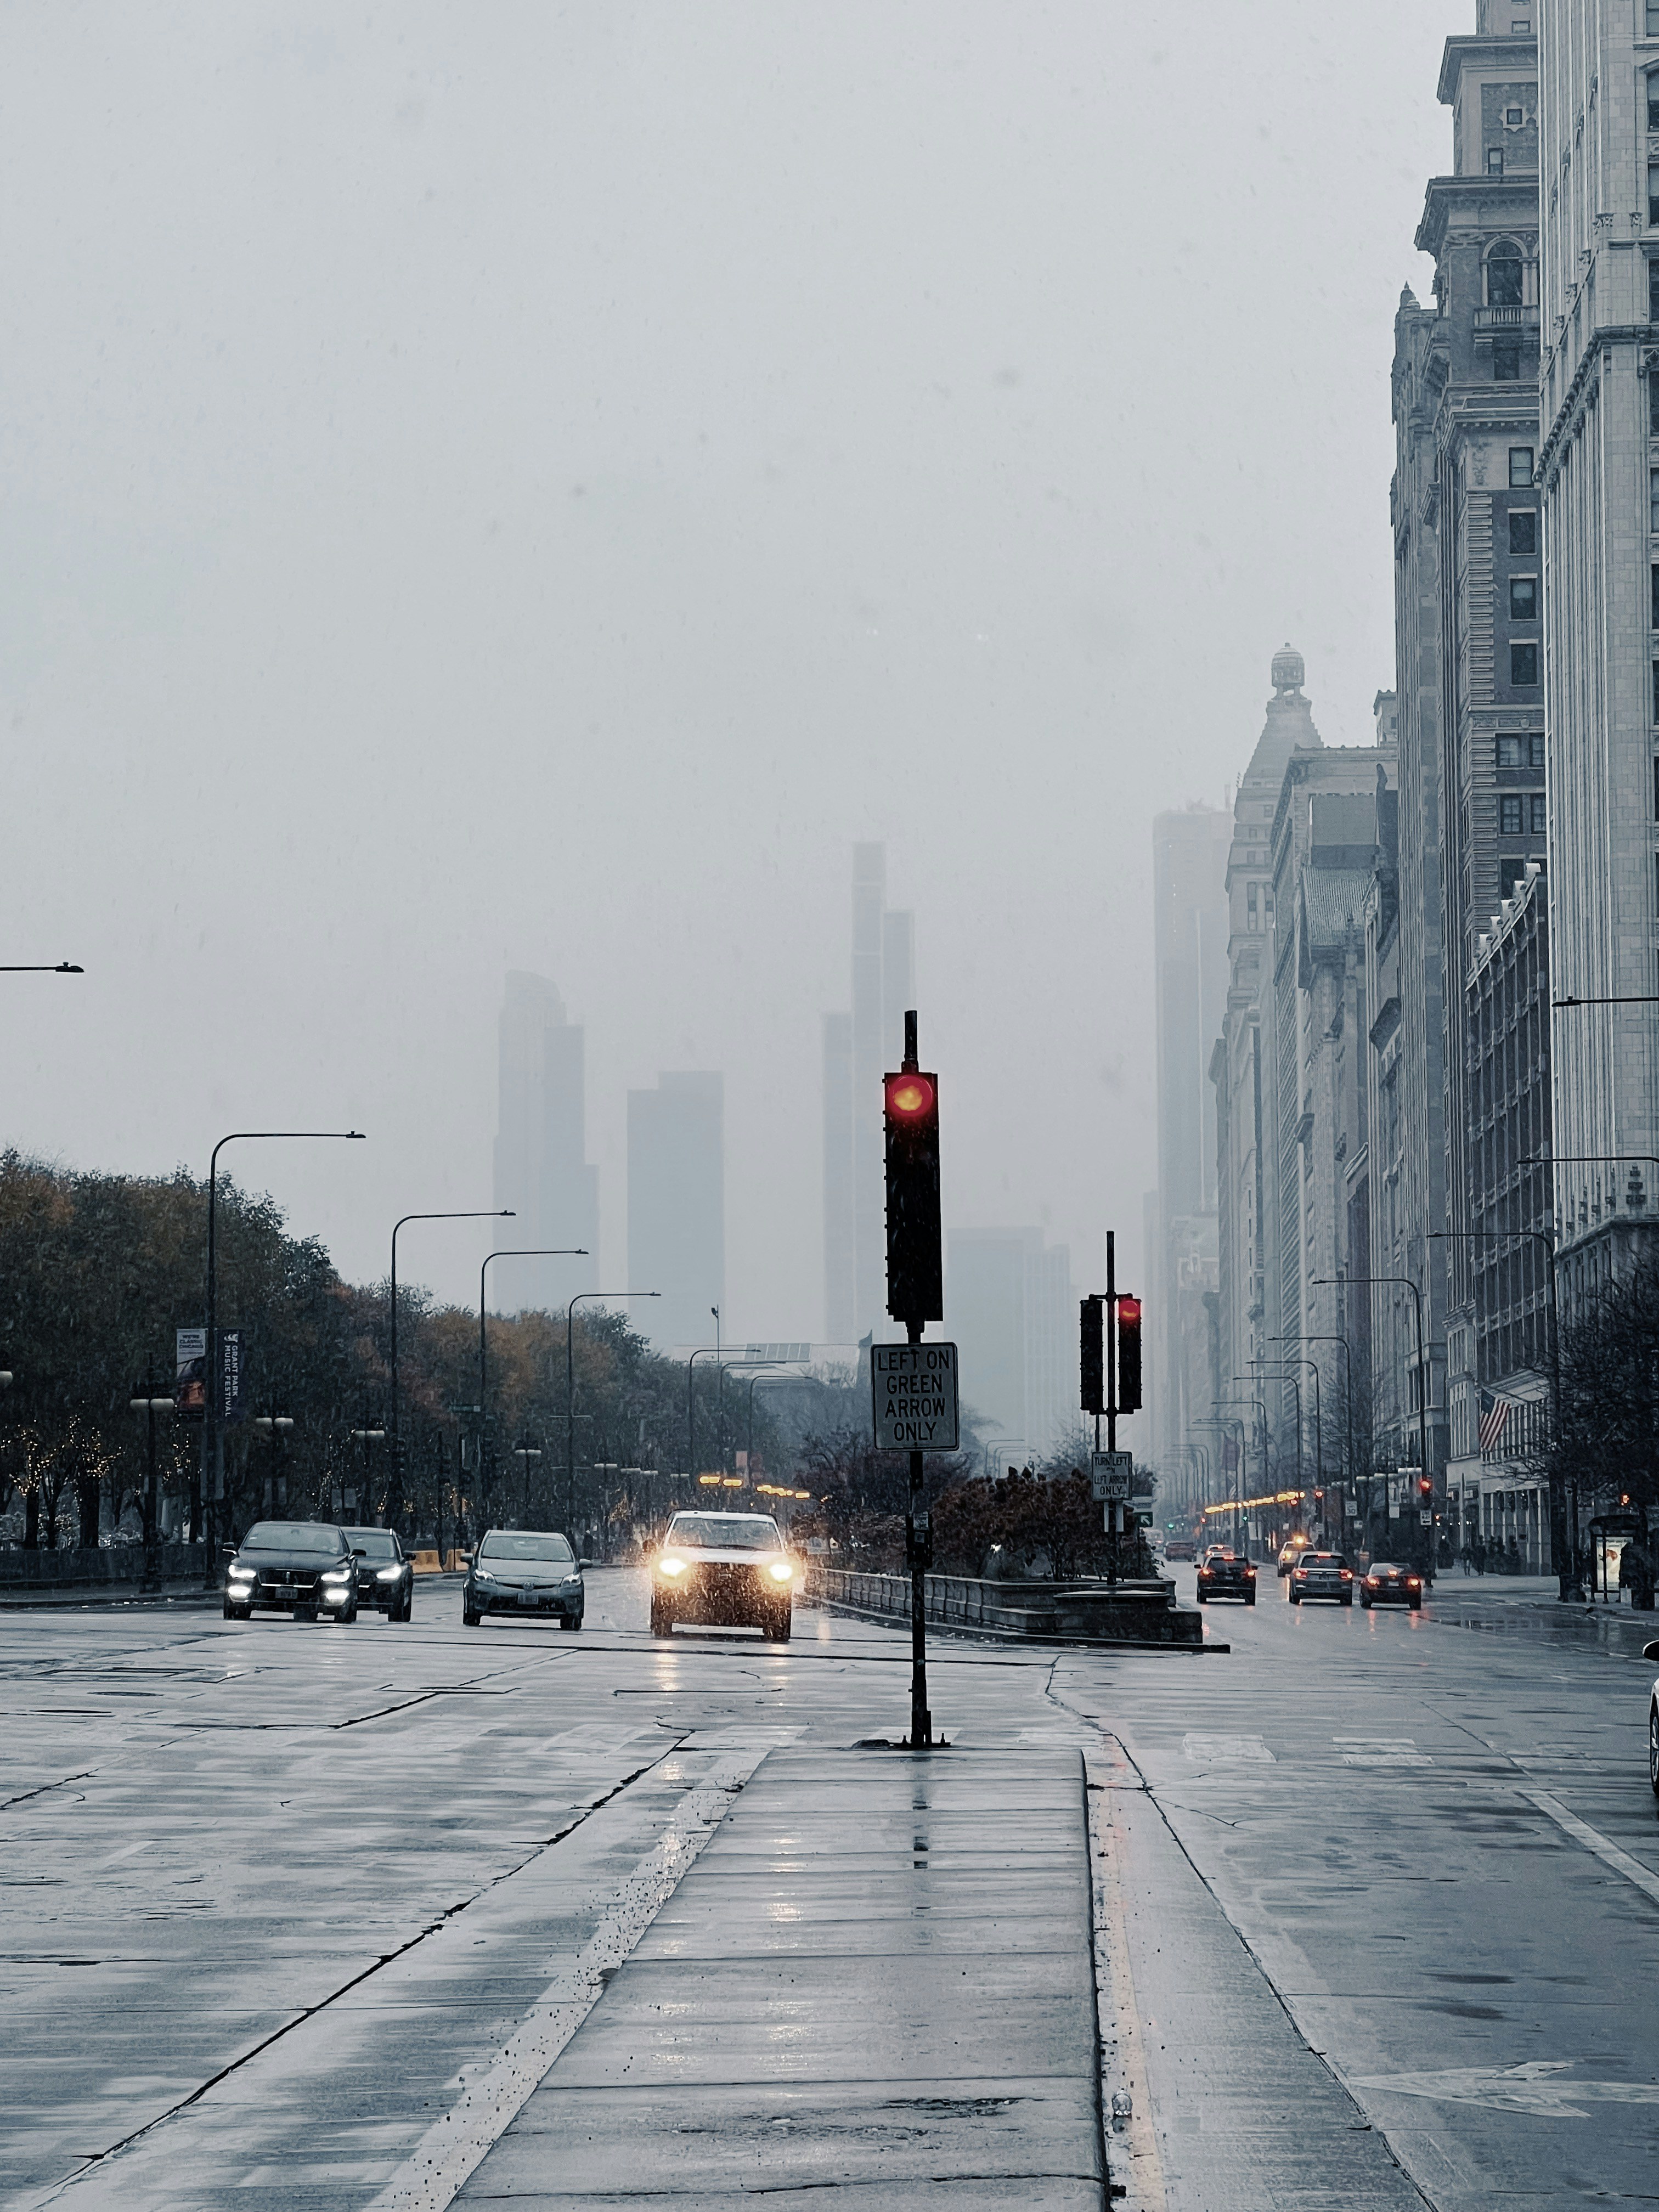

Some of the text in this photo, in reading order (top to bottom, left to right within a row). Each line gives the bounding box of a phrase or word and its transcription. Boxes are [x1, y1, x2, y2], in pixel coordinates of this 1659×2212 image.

[878, 1350, 950, 1371] LEFT ON
[887, 1374, 943, 1395] GREEN
[885, 1397, 945, 1418] ARROW
[894, 1421, 937, 1442] ONLY
[1094, 1457, 1127, 1466] TURN LEFT
[1094, 1475, 1128, 1485] LEFT ARROW
[1100, 1486, 1122, 1496] ONLY
